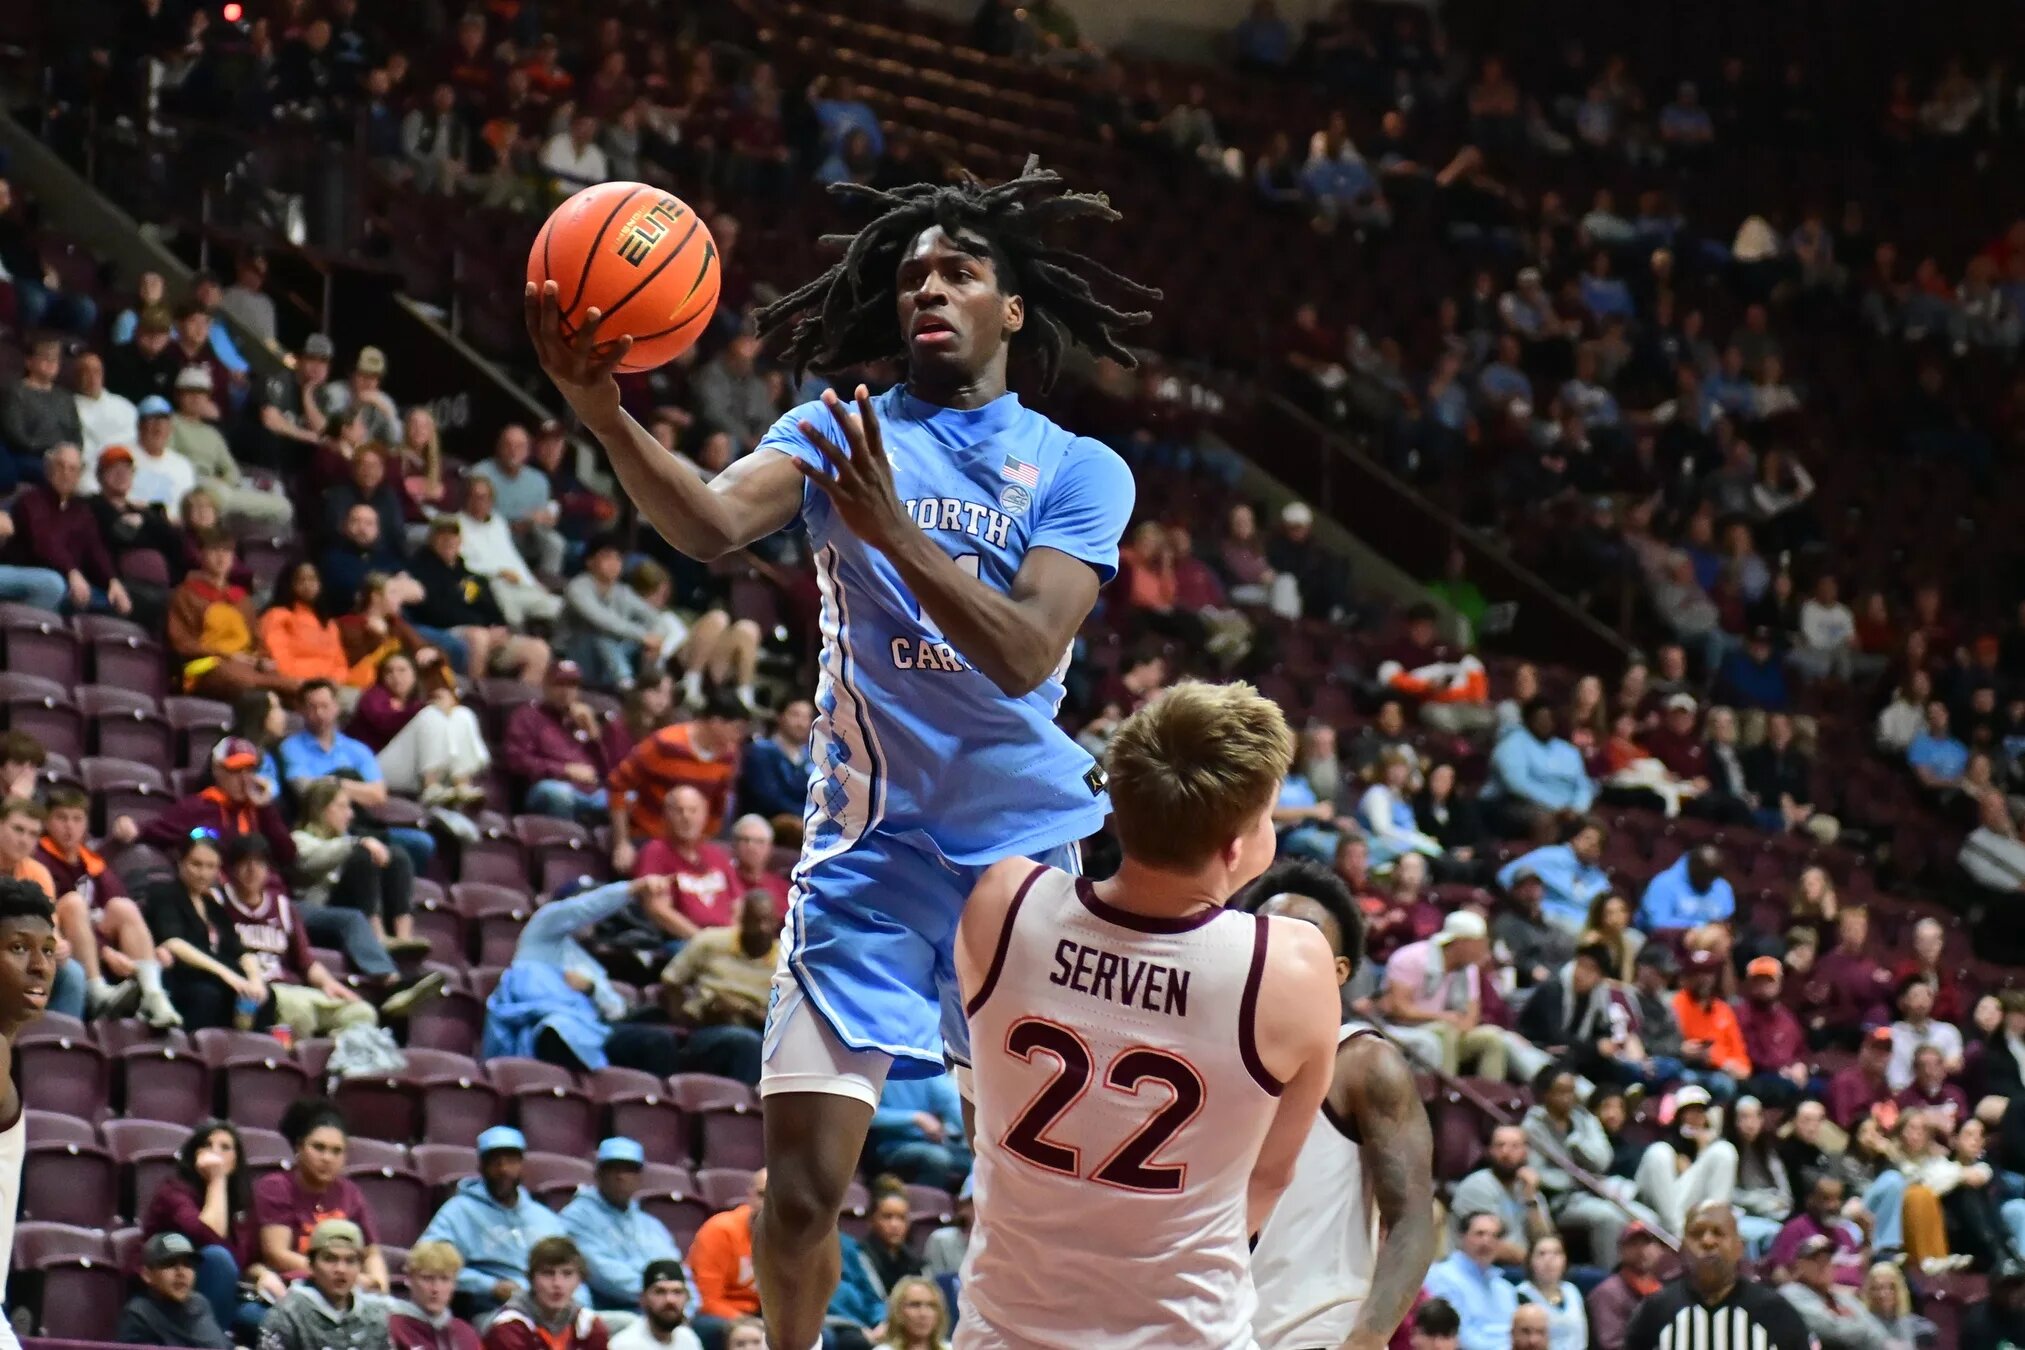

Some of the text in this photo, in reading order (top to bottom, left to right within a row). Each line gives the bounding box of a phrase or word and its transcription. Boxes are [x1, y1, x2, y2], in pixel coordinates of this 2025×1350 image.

[618, 199, 683, 267] ELITE
[1050, 939, 1191, 1017] SERVEN
[999, 1016, 1207, 1193] 22
